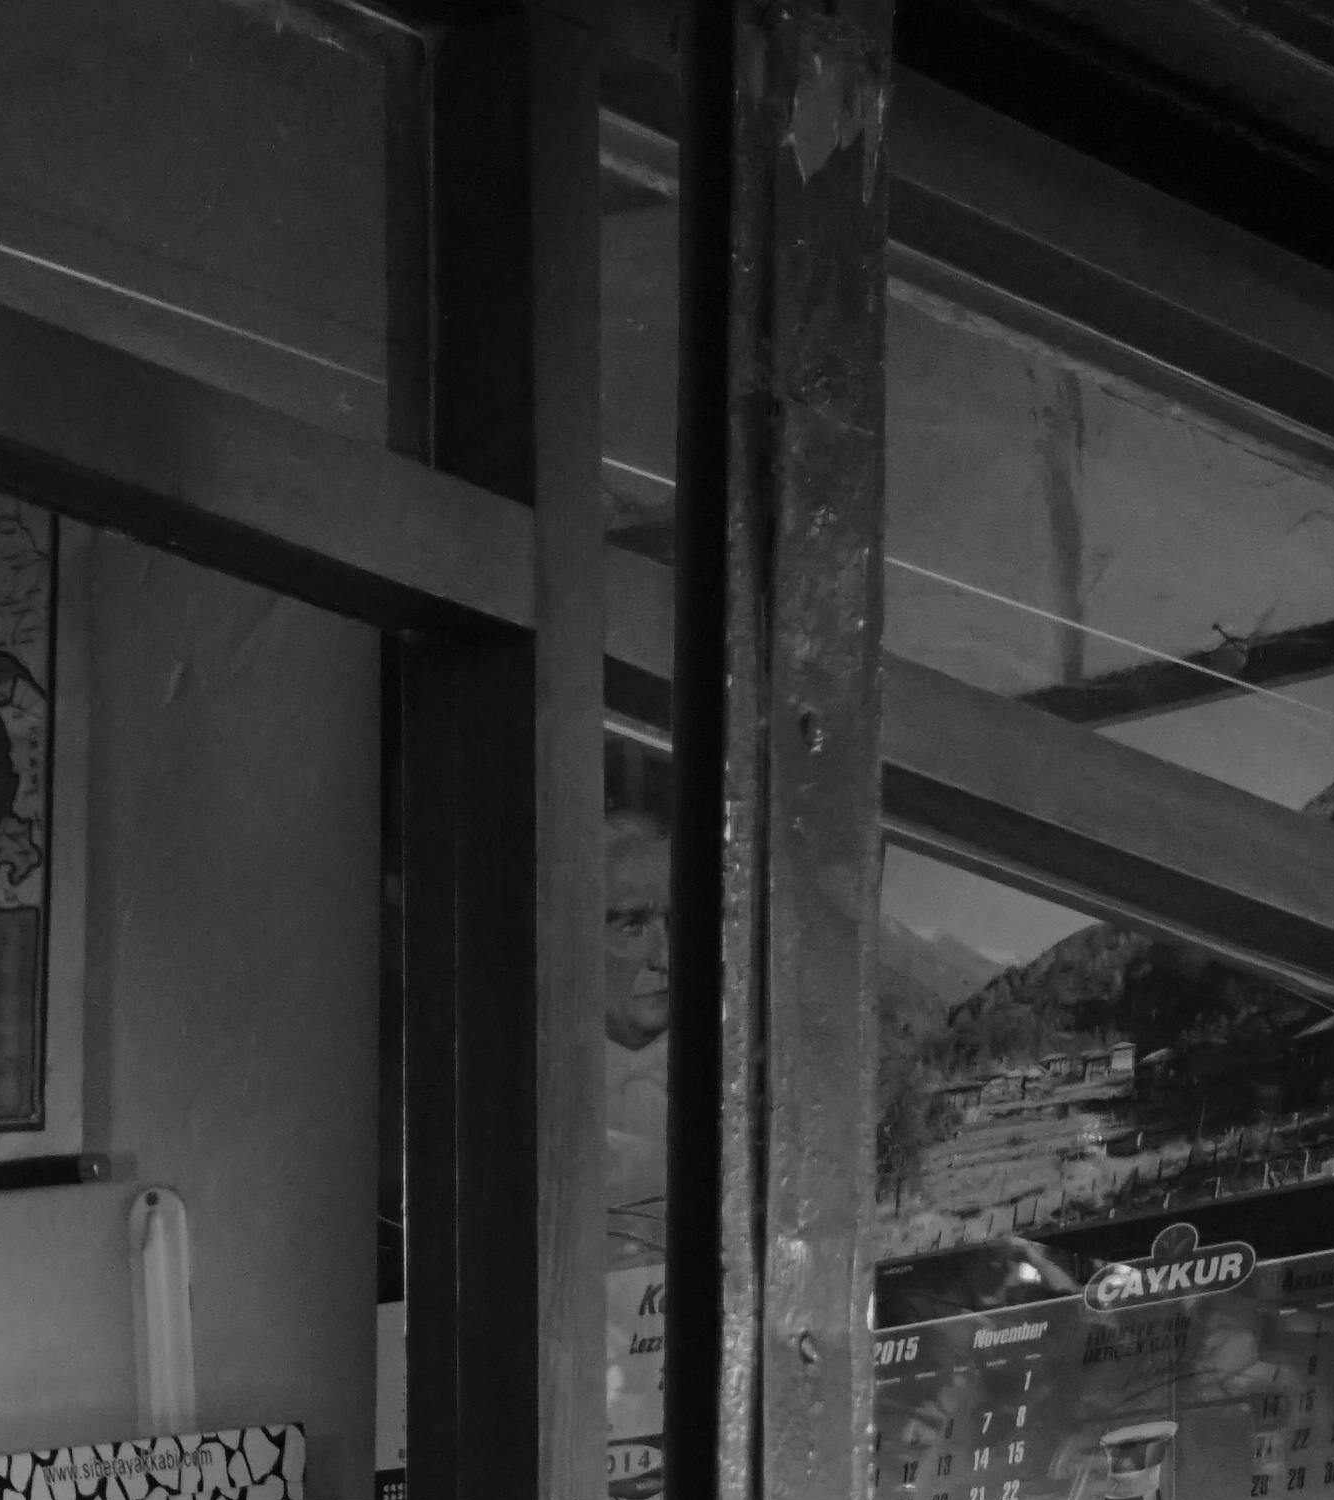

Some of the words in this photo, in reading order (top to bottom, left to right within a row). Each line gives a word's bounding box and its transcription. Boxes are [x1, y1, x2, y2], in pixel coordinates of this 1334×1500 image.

[973, 1320, 1049, 1350] November
[1022, 1370, 1033, 1393] 1
[979, 1411, 993, 1434] 7
[1015, 1405, 1027, 1428] 8
[902, 1461, 919, 1484] 12
[973, 1447, 990, 1472] 14
[1008, 1440, 1025, 1464] 15
